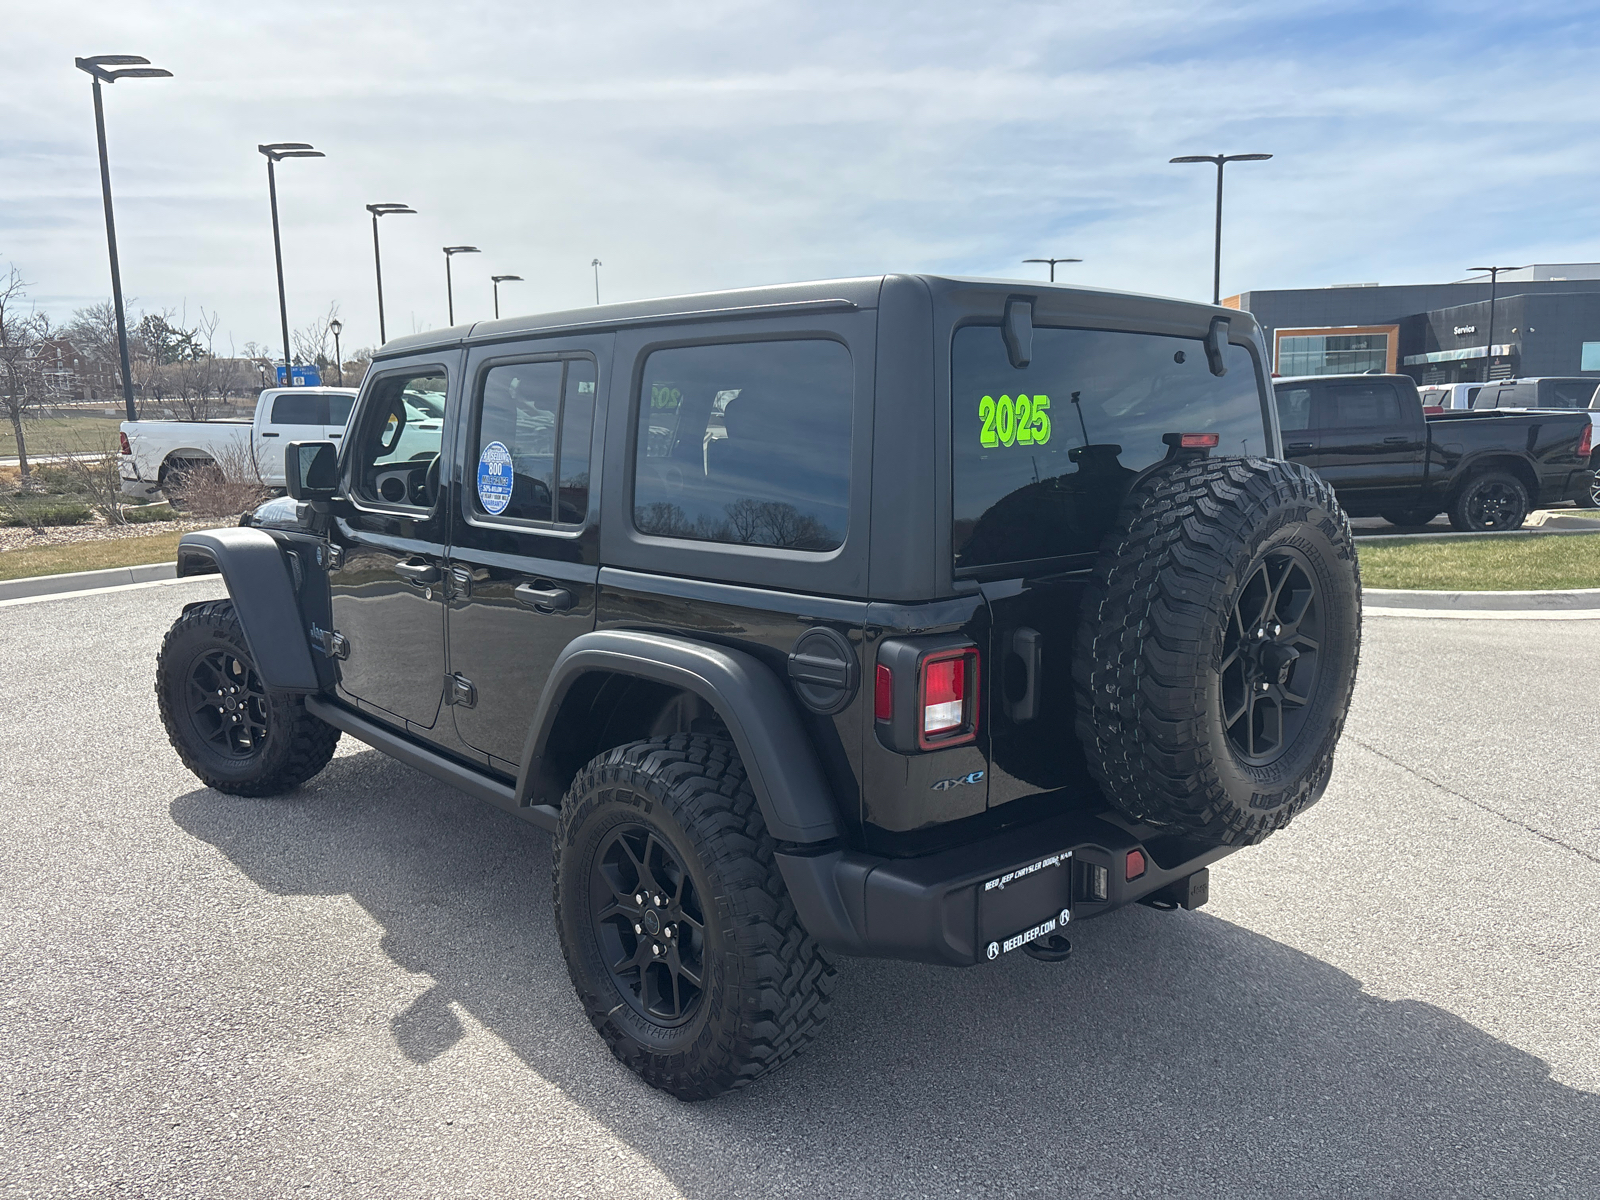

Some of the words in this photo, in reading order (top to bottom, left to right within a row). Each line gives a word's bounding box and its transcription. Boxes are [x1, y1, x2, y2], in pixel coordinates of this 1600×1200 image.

[1453, 324, 1475, 335] Service
[978, 393, 1051, 448] 2025
[985, 878, 1000, 892] REED
[1000, 872, 1014, 884] JEEP
[1014, 861, 1042, 880] CHRYSLER
[1003, 918, 1056, 953] REEDJEEP.COM
